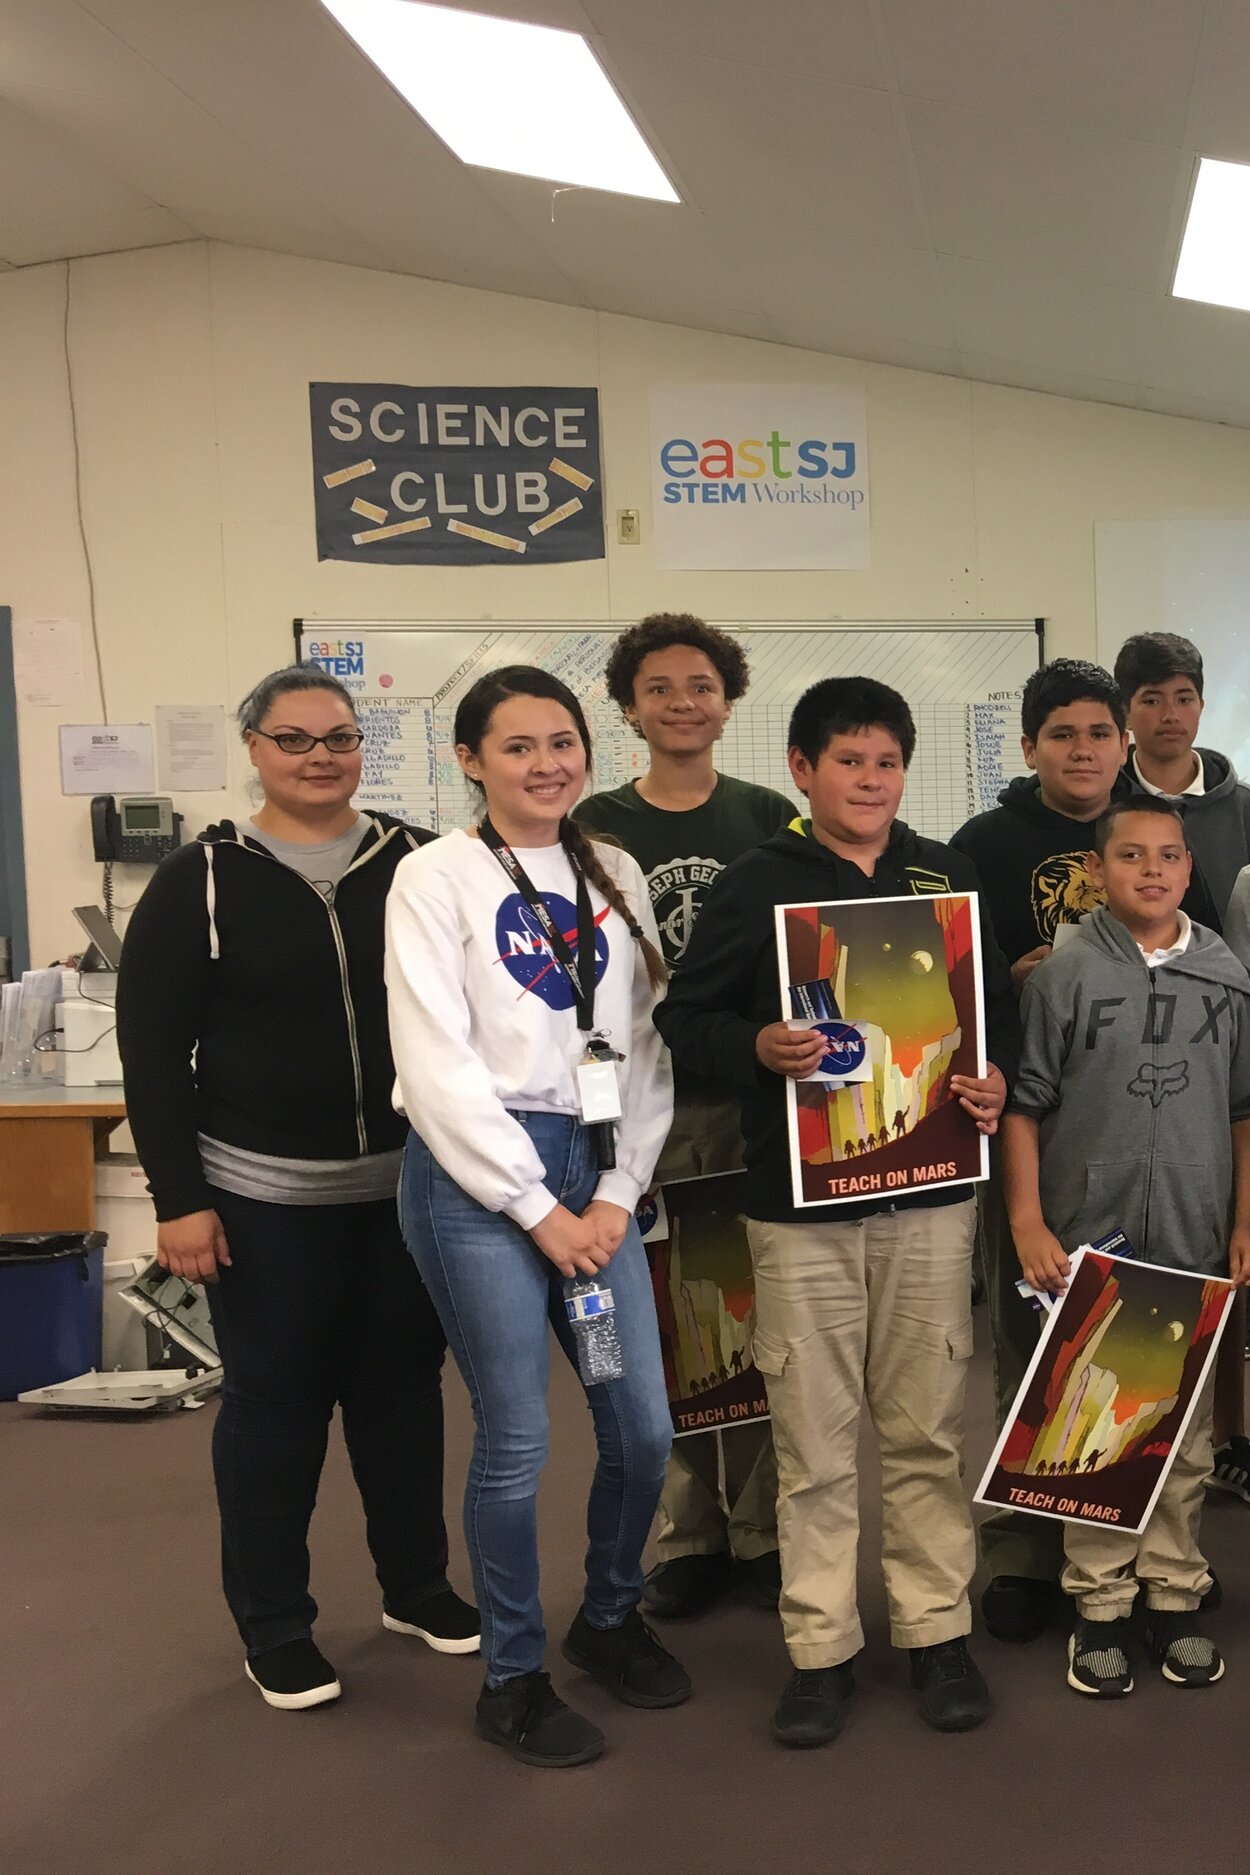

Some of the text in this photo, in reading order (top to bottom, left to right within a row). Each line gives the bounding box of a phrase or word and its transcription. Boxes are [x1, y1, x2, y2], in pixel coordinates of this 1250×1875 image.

[329, 398, 587, 448] SCIENCE
[390, 471, 550, 516] CLUB
[663, 482, 865, 511] STEM Workshop
[988, 691, 1021, 701] NOTES
[1085, 992, 1230, 1051] FOX
[828, 1161, 957, 1195] TEACH ON MARS
[678, 1408, 724, 1428] TEACH
[729, 1403, 749, 1420] ON
[1008, 1487, 1122, 1523] TEACH ON MARS
